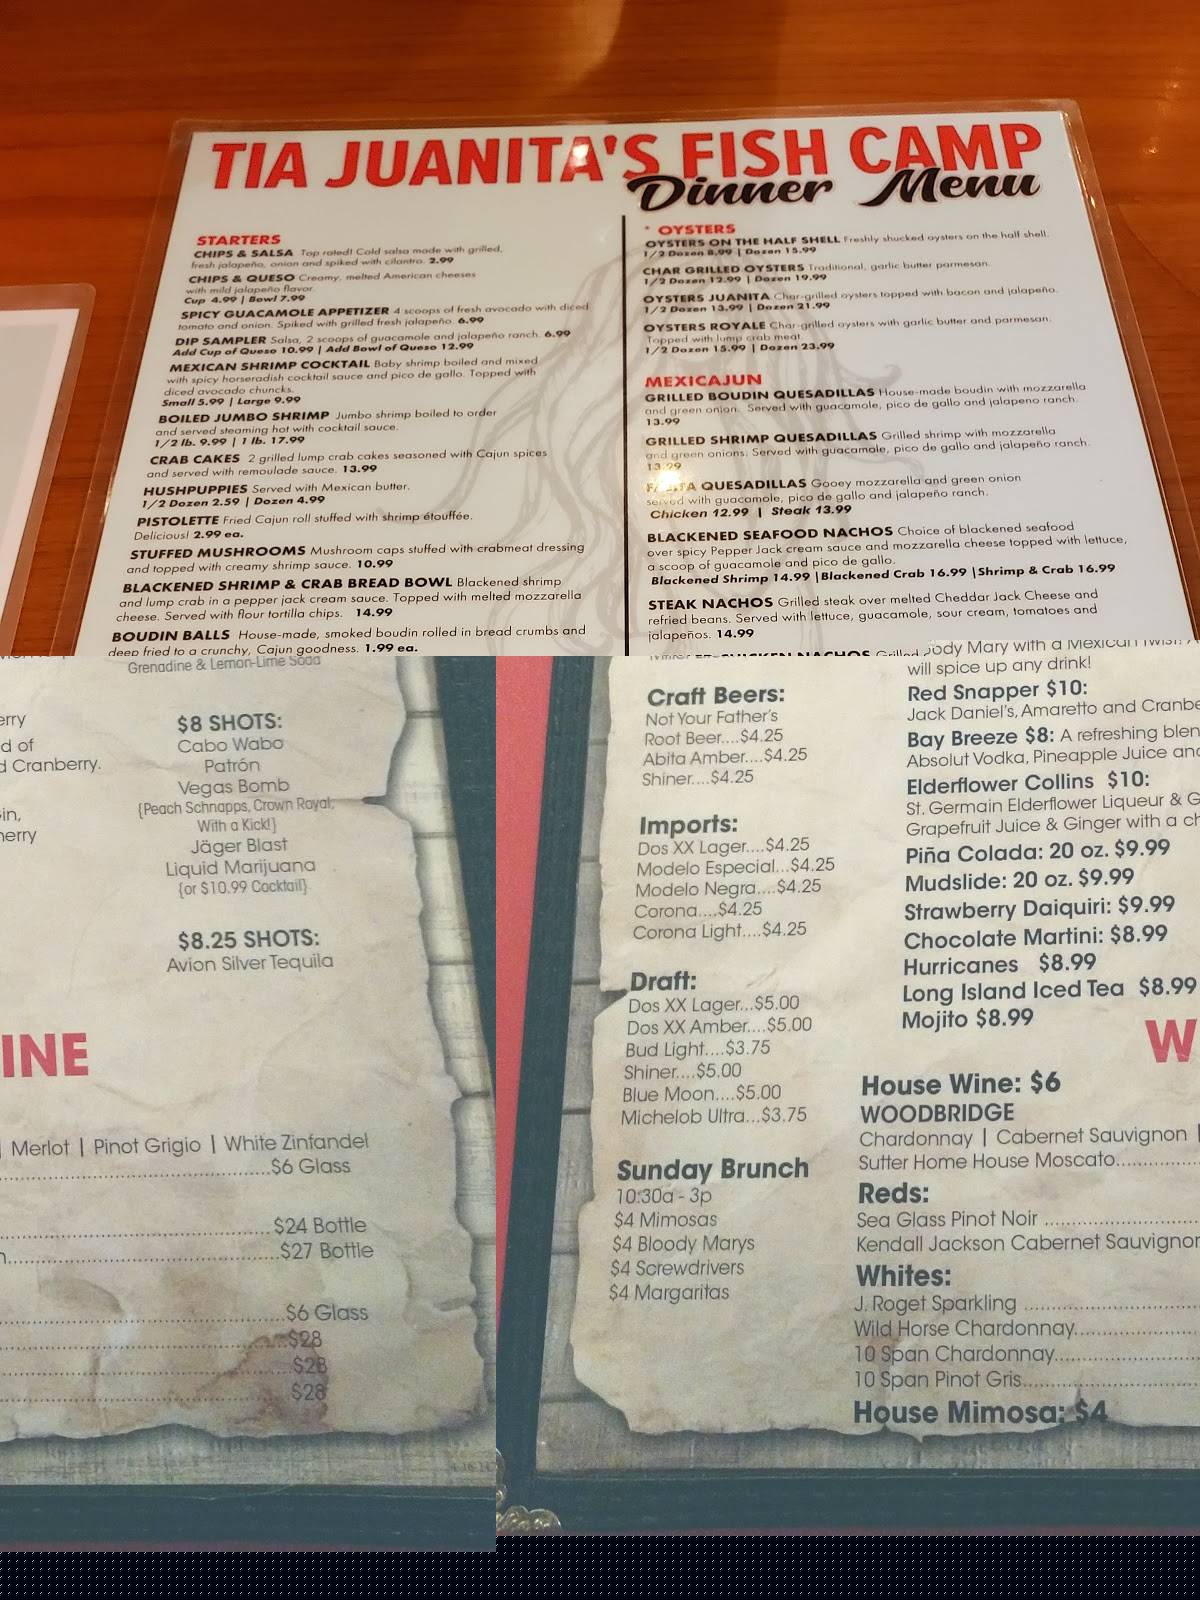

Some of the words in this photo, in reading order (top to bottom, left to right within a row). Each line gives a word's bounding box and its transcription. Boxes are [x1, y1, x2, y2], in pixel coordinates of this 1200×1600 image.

[212, 142, 307, 188] TIA
[324, 133, 661, 188] JUANITA'S
[681, 128, 828, 178] FISH
[849, 123, 1042, 174] CAMP
[626, 174, 834, 212] Dinner
[858, 168, 1042, 206] Menu
[658, 223, 736, 235] OYSTERS
[196, 234, 281, 246] STARTERS
[193, 249, 233, 258] CHIPS
[236, 249, 246, 258] &
[250, 248, 293, 257] SALSA
[301, 249, 319, 257] Top
[356, 247, 381, 255] Cold
[642, 266, 680, 275] CHAR
[684, 265, 740, 274] GRILLED
[743, 263, 805, 273] OYSTERS
[870, 261, 897, 271] garlic
[902, 261, 931, 269] butter
[645, 373, 762, 388] MEXICAJUN
[158, 414, 210, 423] BOILED
[213, 412, 268, 422] JUMBO
[271, 411, 329, 421] SHRIMP
[336, 410, 371, 419] Jumbo
[376, 409, 411, 420] shrimp
[415, 408, 449, 417] boiled
[467, 407, 495, 416] order
[645, 436, 705, 446] GRILLED
[710, 434, 769, 445] SHRIMP
[773, 431, 877, 443] QUESADILLAS
[881, 429, 920, 440] Grilled
[924, 430, 961, 440] shrimp
[965, 428, 987, 437] with
[991, 426, 1055, 436] mozzarella
[143, 484, 247, 496] HUSHPUPPIES
[252, 483, 291, 493] Served
[295, 483, 317, 492] with
[321, 483, 371, 491] Mexican
[375, 481, 408, 490] butter.
[137, 515, 219, 527] PISTOLETTE
[223, 514, 251, 524] Fried
[255, 514, 288, 526] Cajun
[292, 513, 310, 523] roll
[314, 512, 351, 523] stuffed
[355, 511, 378, 521] with
[382, 511, 420, 523] shrimp
[647, 531, 738, 543] BLACKENED
[743, 528, 818, 540] SEAFOOD
[823, 526, 893, 538] NACHOS
[897, 526, 939, 535] Choice
[944, 524, 955, 534] of
[959, 522, 1021, 534] blackened
[1026, 521, 1074, 531] seafood
[130, 548, 193, 560] STUFFED
[197, 545, 305, 558] MUSHROOMS
[310, 545, 372, 555] Mushroom
[376, 547, 404, 556] caps
[408, 543, 446, 553] stuffed
[449, 543, 473, 553] with
[477, 542, 532, 552] crabmeat
[536, 542, 584, 554] dressing
[122, 581, 213, 593] BLACKENED
[217, 579, 280, 591] SHRIMP
[284, 579, 295, 589] &
[301, 578, 342, 589] CRAB
[347, 577, 399, 588] BREAD
[404, 577, 452, 587] BOWL
[457, 576, 518, 587] Blackened
[522, 575, 561, 588] shrimp
[648, 599, 697, 610] STEAK
[702, 596, 773, 609] NACHOS
[777, 595, 819, 607] Grilled
[824, 594, 855, 605] steak
[859, 597, 886, 605] over
[890, 592, 930, 604] melted
[934, 591, 989, 602] Cheddar
[993, 590, 1021, 601] Jack
[1024, 590, 1070, 600] Cheese
[1074, 588, 1098, 599] and
[647, 686, 706, 707] Craft
[714, 686, 784, 704] Beers:
[908, 684, 946, 701] Red
[953, 684, 1039, 702] Snapper
[1046, 679, 1087, 698] $10:
[177, 714, 202, 734] $8
[209, 712, 282, 731] SHOTS:
[177, 738, 228, 753] Cabo
[231, 736, 283, 751] Wabo
[204, 757, 260, 773] Patrón
[177, 780, 233, 798] Vegas
[238, 777, 289, 793] Bomb
[907, 776, 1018, 795] Elderflower
[1024, 773, 1094, 790] Collins
[1107, 770, 1149, 789] $10:
[639, 814, 737, 839] Imports:
[190, 839, 242, 857] Jäger
[246, 837, 288, 852] Blast
[906, 846, 950, 864] Piña
[957, 843, 1043, 862] Colada:
[1049, 841, 1073, 859] 20
[1080, 845, 1108, 858] oz.
[1114, 838, 1170, 858] $9.99
[165, 860, 218, 879] Liquid
[224, 858, 316, 877] Marijuana
[904, 901, 1016, 921] Strawberry
[1023, 897, 1111, 919] Daiquiri:
[1118, 895, 1175, 915] $9.99
[178, 931, 236, 951] $8.25
[243, 928, 319, 948] SHOTS:
[904, 929, 1016, 950] Chocolate
[1023, 926, 1103, 946] Martini:
[1110, 924, 1167, 944] $8.99
[166, 957, 216, 972] Avion
[221, 955, 267, 971] Silver
[268, 952, 334, 972] Tequila
[903, 957, 1018, 975] Hurricanes
[1039, 952, 1096, 973] $8.99
[630, 970, 696, 991] Draft:
[902, 1010, 968, 1033] Mojito
[976, 1007, 1033, 1029] $8.99
[861, 1075, 941, 1096] House
[948, 1072, 1020, 1094] Wine:
[1030, 1069, 1060, 1094] $6
[860, 1102, 1014, 1123] WOODBRIDGE
[616, 1158, 713, 1183] Sunday
[720, 1156, 808, 1179] Brunch
[858, 1181, 928, 1204] Reds:
[274, 1216, 308, 1236] $24
[313, 1216, 366, 1234] Bottle
[613, 1210, 634, 1229] $4
[639, 1211, 717, 1227] Mimosas
[612, 1234, 632, 1255] $4
[637, 1235, 697, 1255] Bloody
[702, 1234, 755, 1255] Marys
[855, 1263, 951, 1286] Whites:
[872, 1295, 926, 1316] Roget
[931, 1293, 1016, 1315] Sparkling
[854, 1400, 938, 1426] House
[948, 1400, 1066, 1424] Mimosa:
[1075, 1399, 1108, 1423] $4
